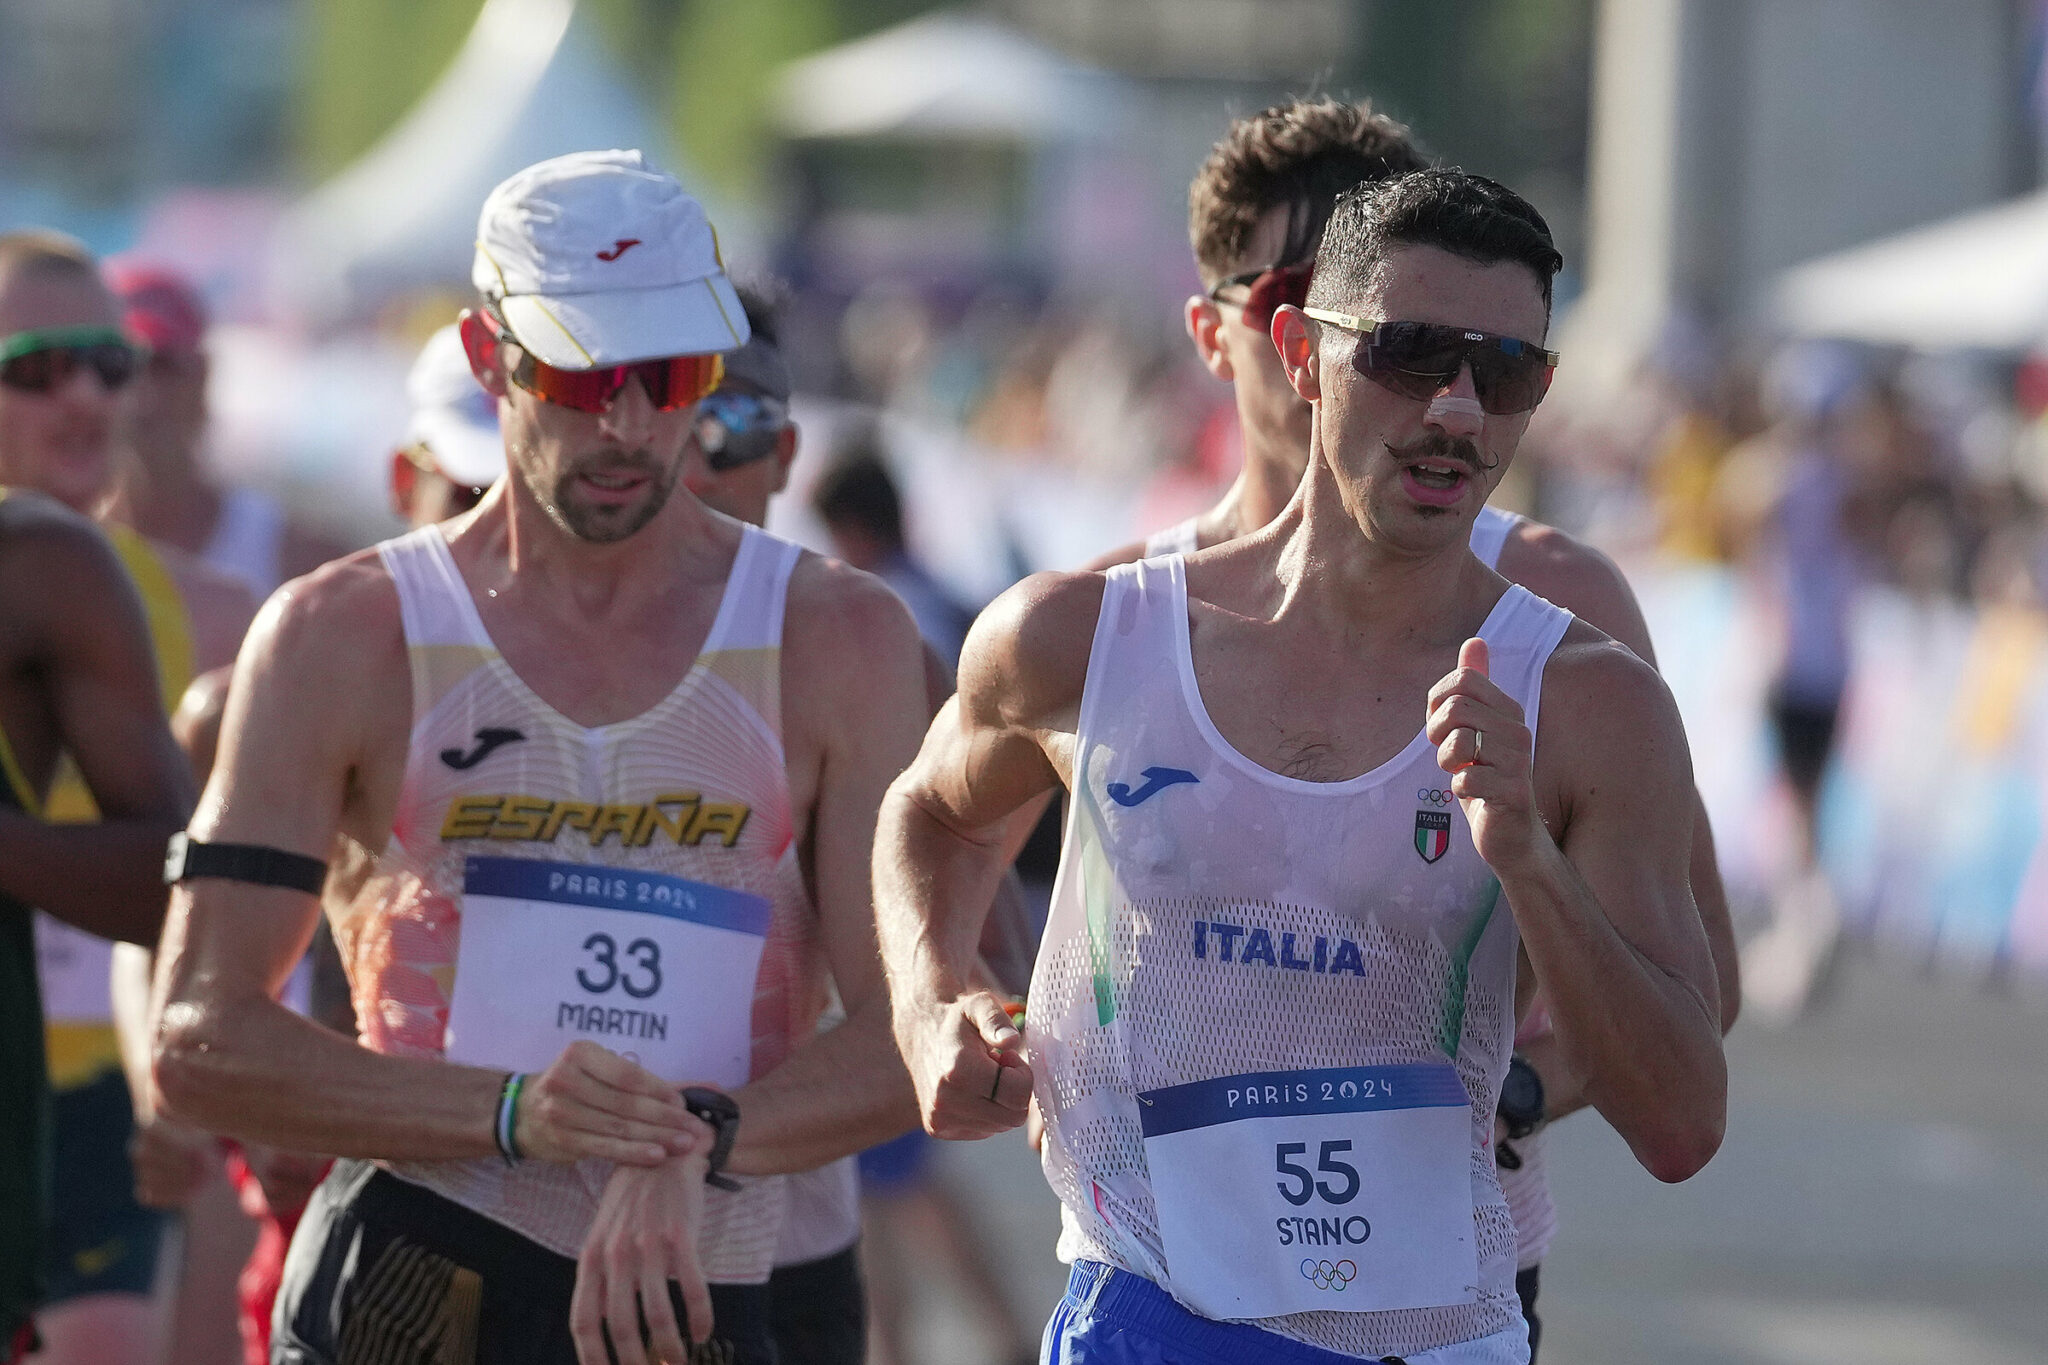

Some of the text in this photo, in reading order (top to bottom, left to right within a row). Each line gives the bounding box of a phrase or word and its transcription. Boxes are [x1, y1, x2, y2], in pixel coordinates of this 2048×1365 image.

[441, 793, 750, 847] ESPAÑA
[1418, 814, 1448, 823] ITALIA
[636, 881, 697, 911] 2024
[576, 931, 662, 998] 33
[1194, 920, 1367, 978] ITALIA
[556, 1001, 668, 1041] MARTIN
[1320, 1078, 1393, 1101] 2024
[1276, 1139, 1361, 1206] 55
[1276, 1215, 1371, 1246] STANO
